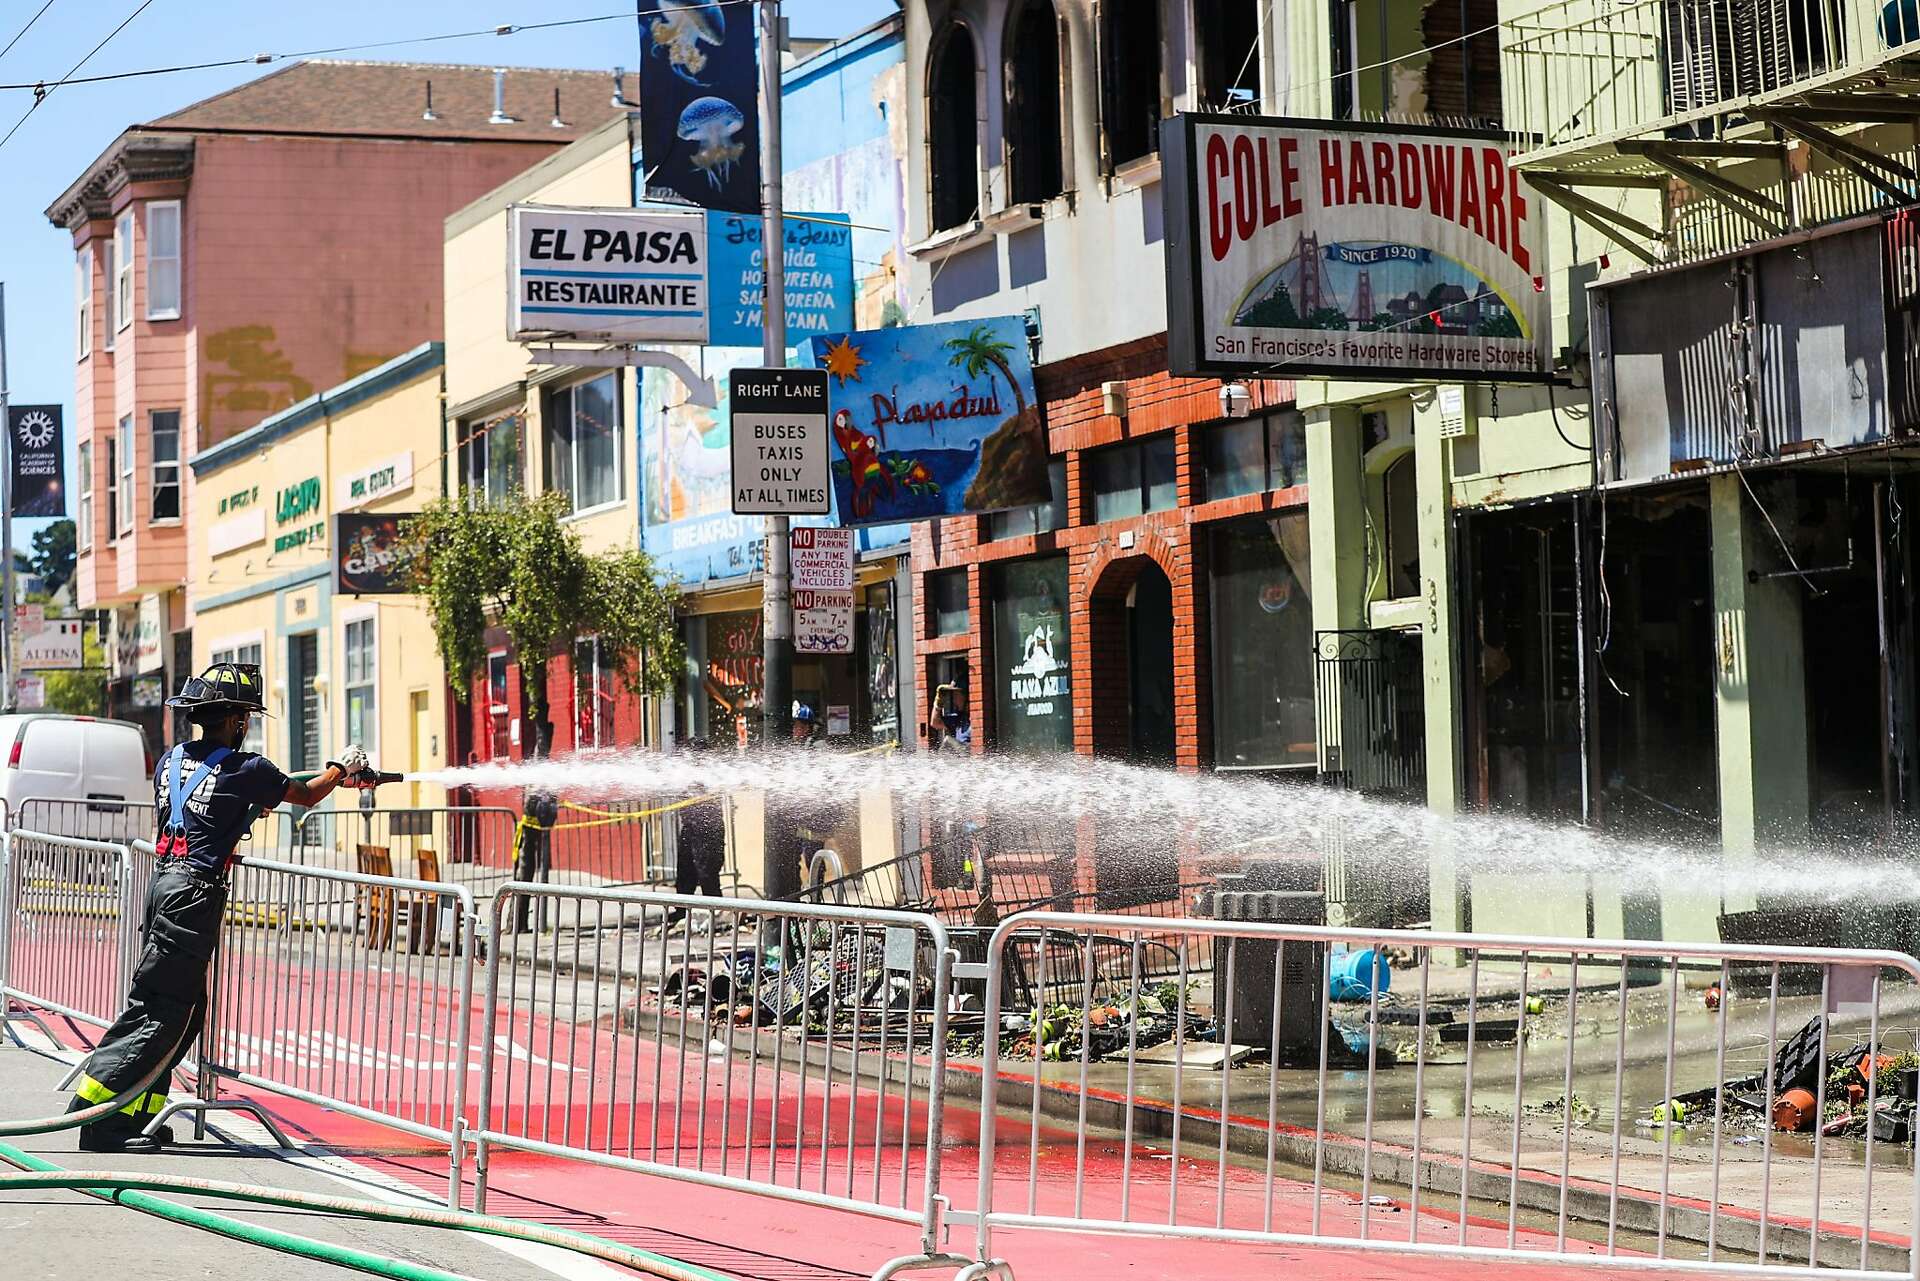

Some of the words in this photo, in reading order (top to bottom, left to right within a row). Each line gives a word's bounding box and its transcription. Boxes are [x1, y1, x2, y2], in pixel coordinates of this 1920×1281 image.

[1206, 132, 1303, 262] COLE
[1319, 137, 1531, 275] HARDWARE
[530, 228, 576, 261] EL
[582, 229, 698, 265] PAISA
[751, 246, 817, 268] Cida
[1340, 248, 1378, 263] SINCE
[1384, 246, 1416, 260] 1920
[741, 270, 834, 289] HOUREÑA
[527, 281, 697, 306] RESTAURANTE
[1215, 336, 1245, 354] San
[1252, 337, 1336, 358] Francisco's
[1342, 340, 1403, 360] Favorite
[1409, 343, 1481, 364] Hardware
[1486, 345, 1538, 366] Stores!
[738, 384, 779, 397] RIGHT
[785, 385, 821, 397] LANE
[755, 425, 806, 439] BUSES
[758, 446, 804, 460] TAXIS
[20, 466, 56, 475] SCIENCES
[761, 468, 801, 481] ONLY
[738, 489, 753, 502] AT
[758, 489, 783, 502] ALL
[787, 489, 824, 502] TIMES
[673, 515, 744, 550] BREAKFAST
[795, 530, 811, 546] NO
[817, 531, 848, 539] DOUBLE
[817, 541, 849, 549] PARKING
[801, 552, 820, 560] ANY
[825, 552, 845, 560] TIME
[794, 560, 850, 569] COMMERCIAL
[801, 569, 845, 577] VEHICLES
[799, 578, 845, 586] INCLUDED
[796, 591, 812, 608] NO
[815, 596, 852, 608] PARKING
[26, 648, 79, 660] ALTENA
